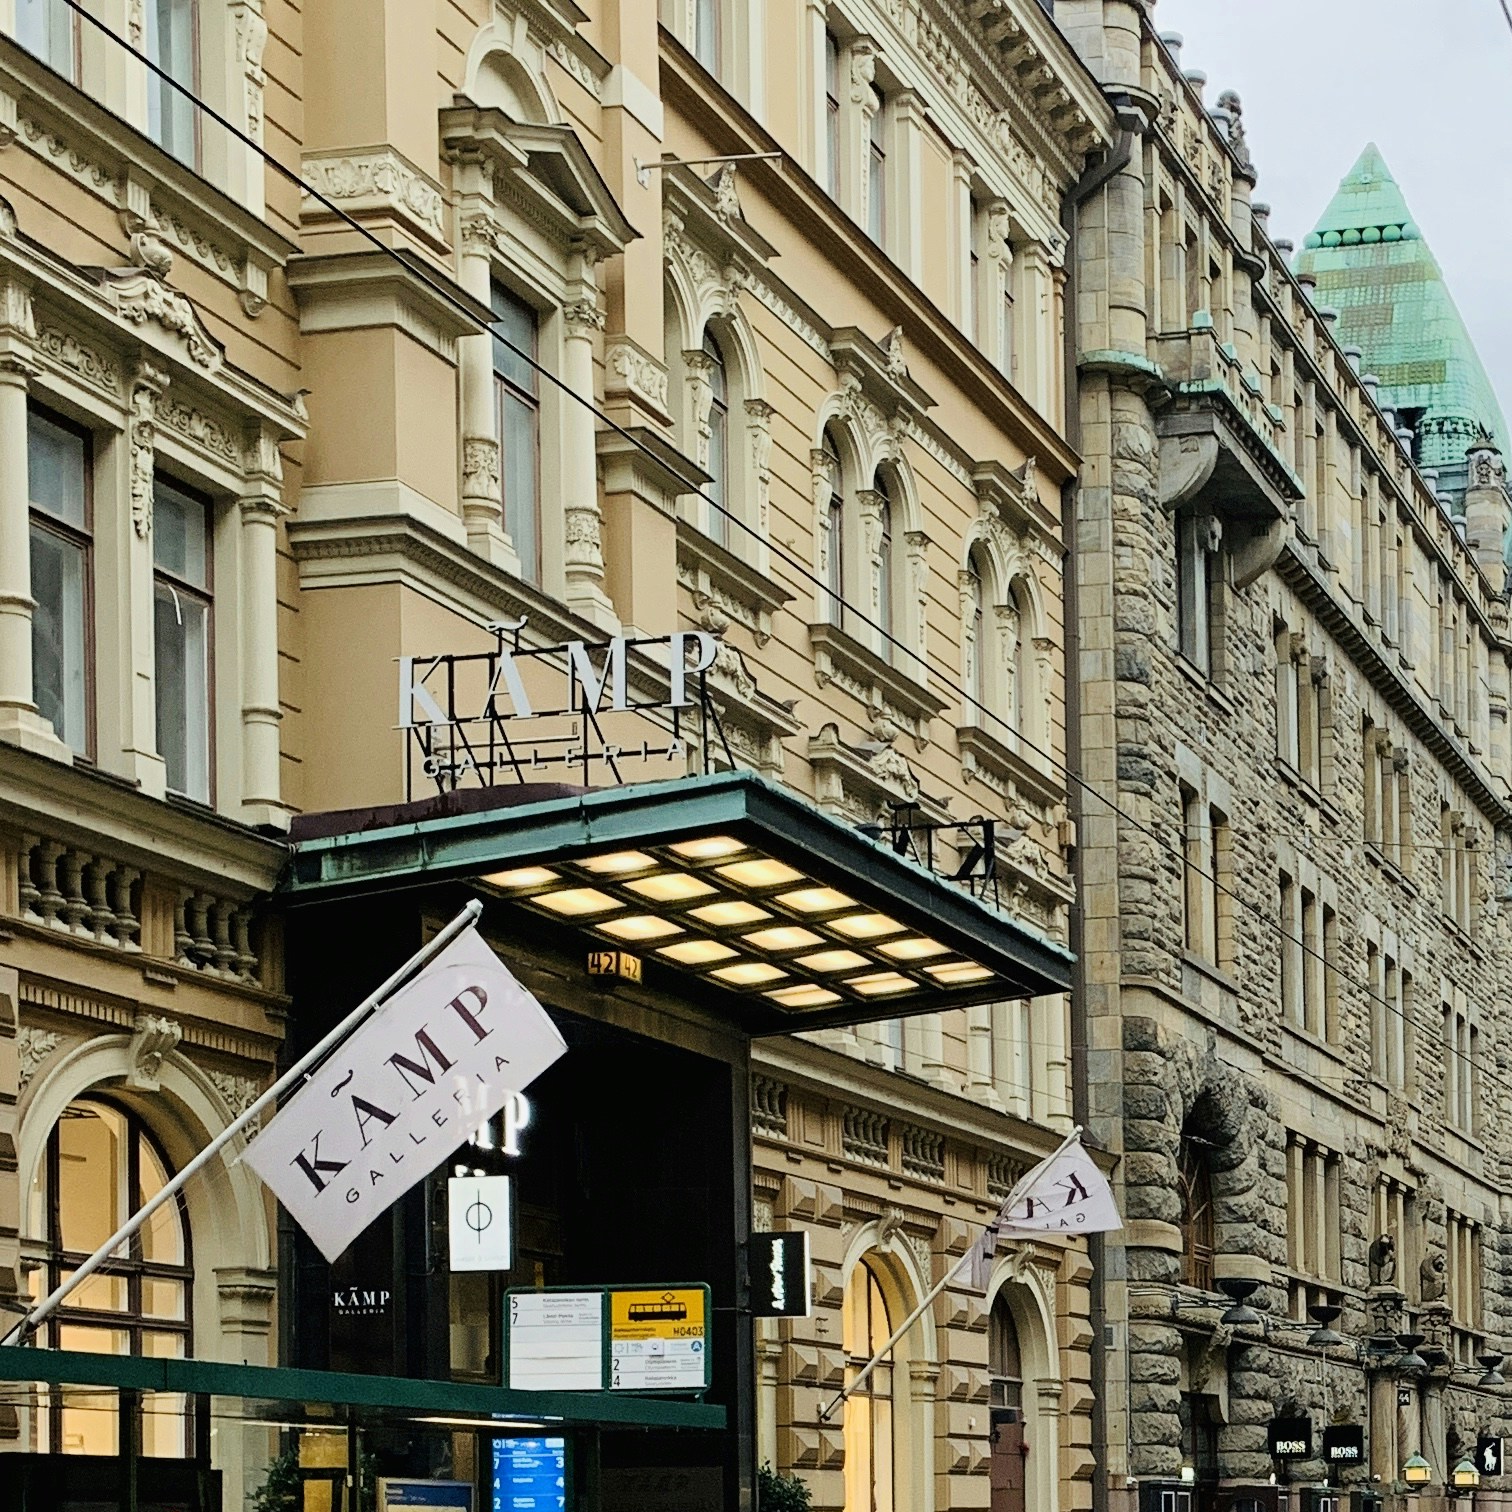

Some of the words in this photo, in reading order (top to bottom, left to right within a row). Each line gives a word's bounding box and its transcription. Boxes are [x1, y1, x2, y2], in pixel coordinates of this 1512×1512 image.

[421, 737, 685, 778] GALLERIA
[590, 953, 613, 973] 42
[624, 955, 637, 978] 42
[344, 1055, 510, 1205] GALLERIA
[512, 1297, 518, 1309] 5
[512, 1313, 518, 1325] 7
[613, 1359, 620, 1371] 2
[613, 1375, 621, 1387] 4
[1276, 1440, 1306, 1451] BOSS
[1330, 1446, 1358, 1455] BOSS
